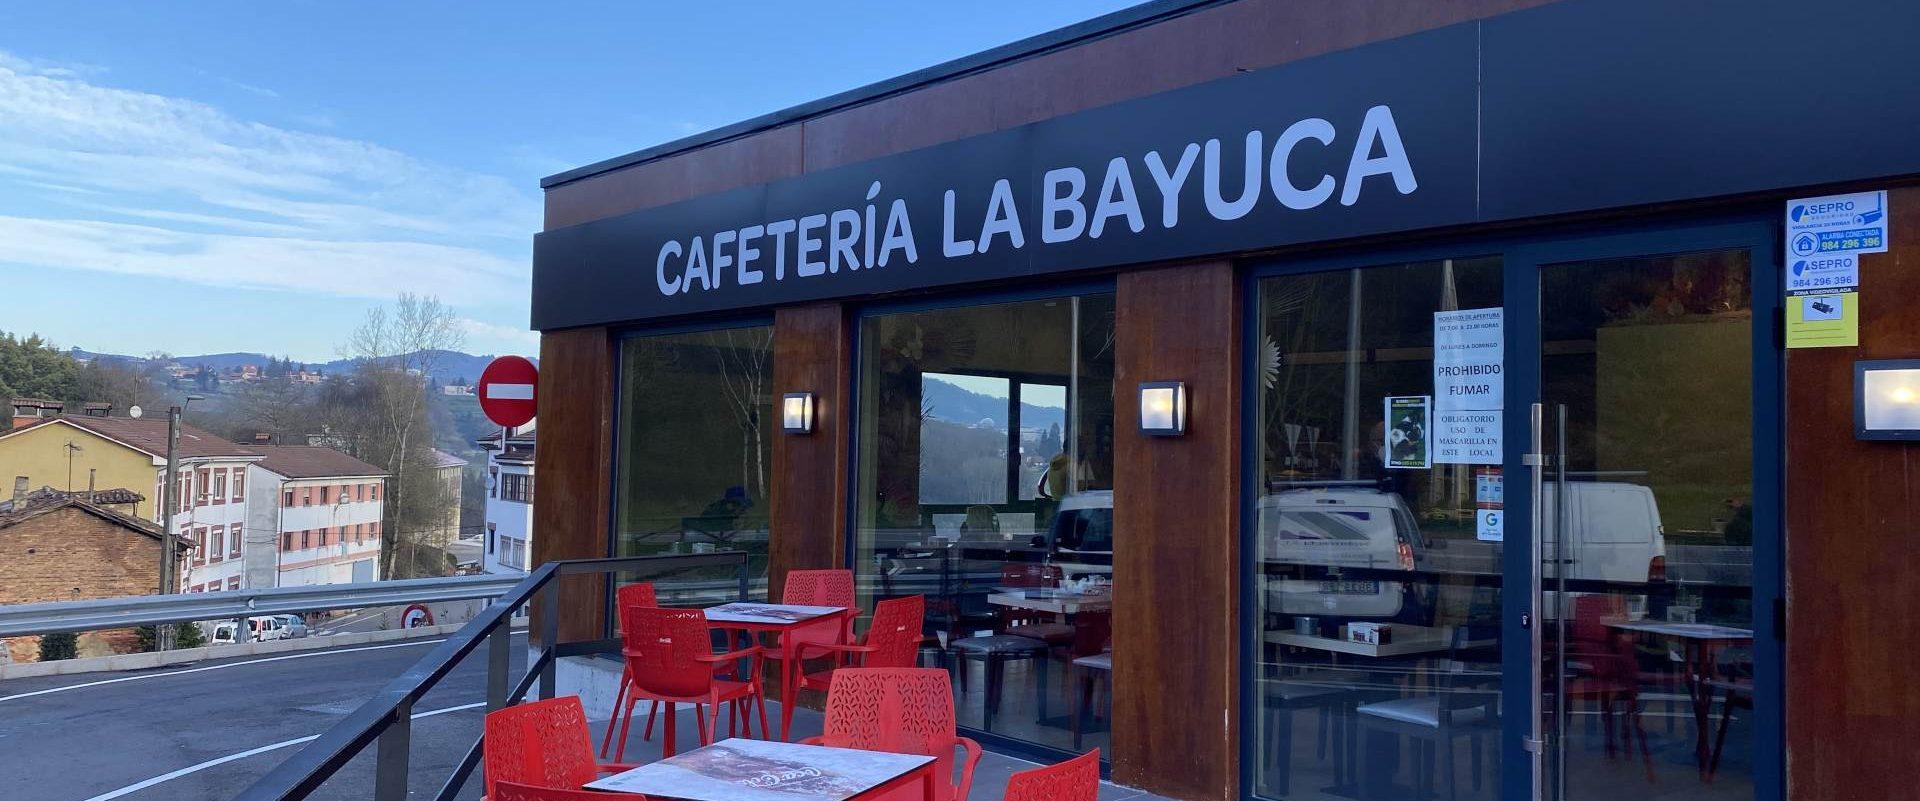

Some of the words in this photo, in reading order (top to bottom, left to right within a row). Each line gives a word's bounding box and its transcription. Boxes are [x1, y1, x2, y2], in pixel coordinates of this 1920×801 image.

[656, 180, 918, 296] CAFETERÍA
[943, 178, 1025, 258] LA
[1041, 105, 1418, 244] BAYUCA
[1822, 232, 1845, 241] ALARMA
[1845, 228, 1880, 239] CONECTADA
[1821, 241, 1840, 251] 984
[1842, 239, 1859, 249] 296
[1862, 237, 1880, 248] 396
[1792, 278, 1811, 287] 984
[1813, 277, 1832, 286] 296
[1834, 276, 1852, 285] 396
[1472, 312, 1501, 320] APERTURA
[1438, 364, 1501, 377] PROHIBIDO
[1449, 384, 1490, 396] FUMAR
[1441, 415, 1495, 423] OBLIGATORIO
[1450, 426, 1466, 434] USO
[1474, 426, 1485, 434] DE
[1441, 448, 1459, 456] ESTE
[1469, 448, 1494, 456] LOCAL
